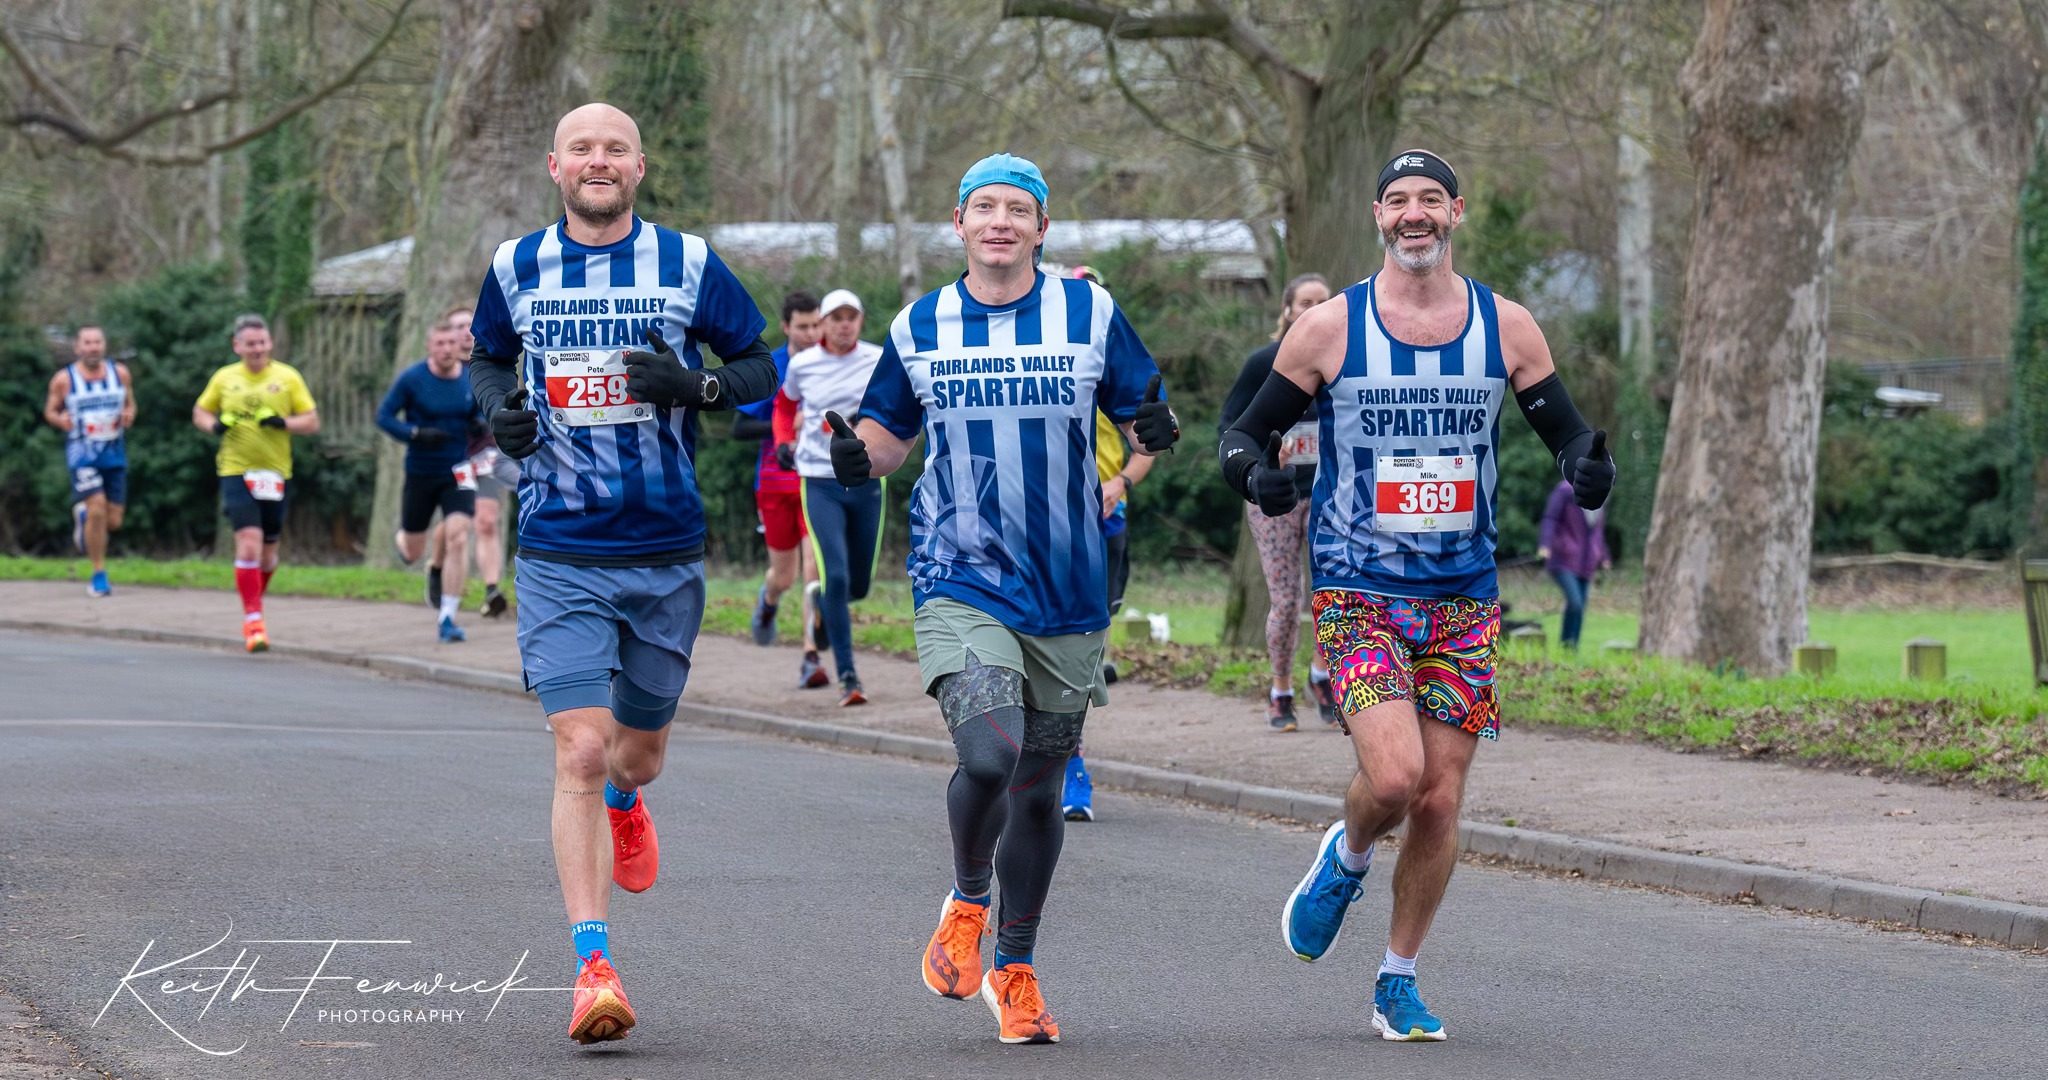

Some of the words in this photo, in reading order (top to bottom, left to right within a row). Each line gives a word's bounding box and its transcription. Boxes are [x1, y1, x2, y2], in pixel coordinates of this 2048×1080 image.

[531, 299, 609, 316] FAIRLANDS
[614, 298, 667, 314] VALLEY
[531, 317, 666, 347] SPARTANS
[930, 357, 1016, 377] FAIRLANDS
[1021, 356, 1076, 373] VALLEY
[567, 375, 629, 407] 259
[932, 376, 1076, 410] SPARTANS
[1357, 388, 1440, 405] FAIRLANDS
[1445, 389, 1491, 404] VALLEY
[1360, 408, 1487, 437] SPARTANS
[1454, 457, 1463, 465] 10
[1399, 482, 1457, 513] 369
